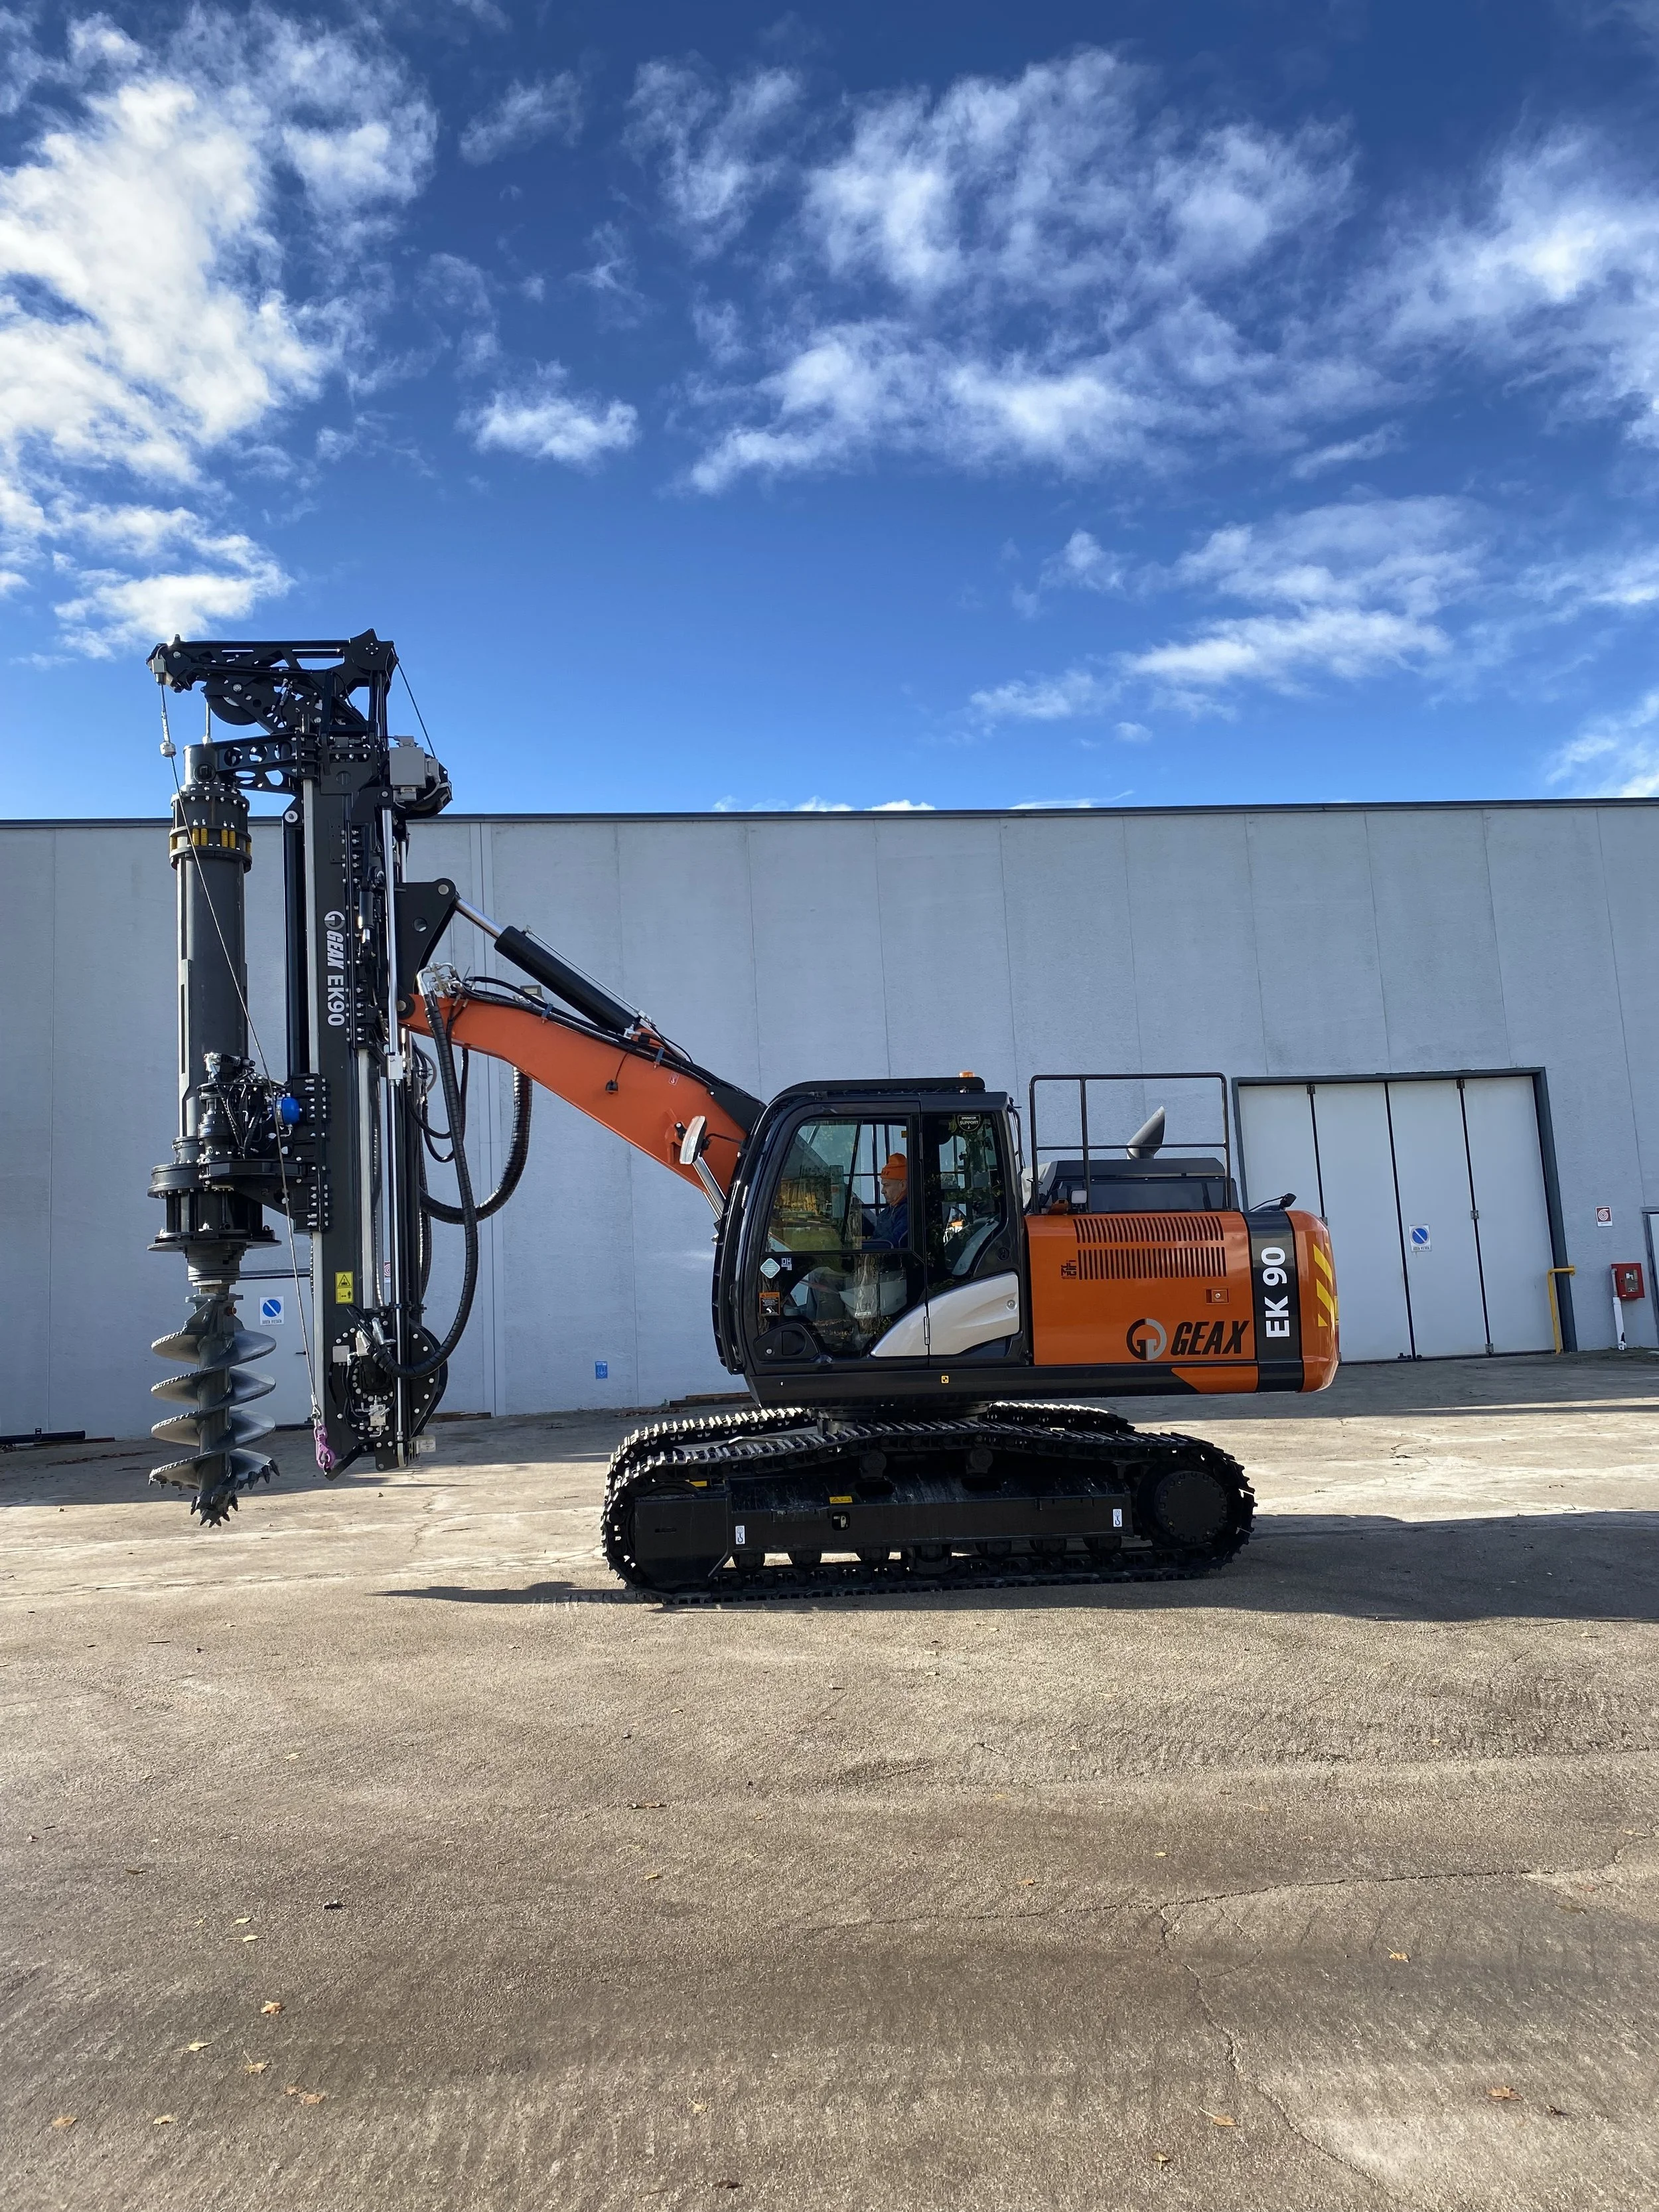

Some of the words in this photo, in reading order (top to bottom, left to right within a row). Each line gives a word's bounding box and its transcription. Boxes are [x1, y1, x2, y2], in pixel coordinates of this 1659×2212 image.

[326, 930, 344, 970] GEAX
[327, 975, 345, 1027] EK90
[1261, 1247, 1287, 1286] 90
[1264, 1295, 1290, 1338] EK
[1170, 1320, 1250, 1356] GEAX
